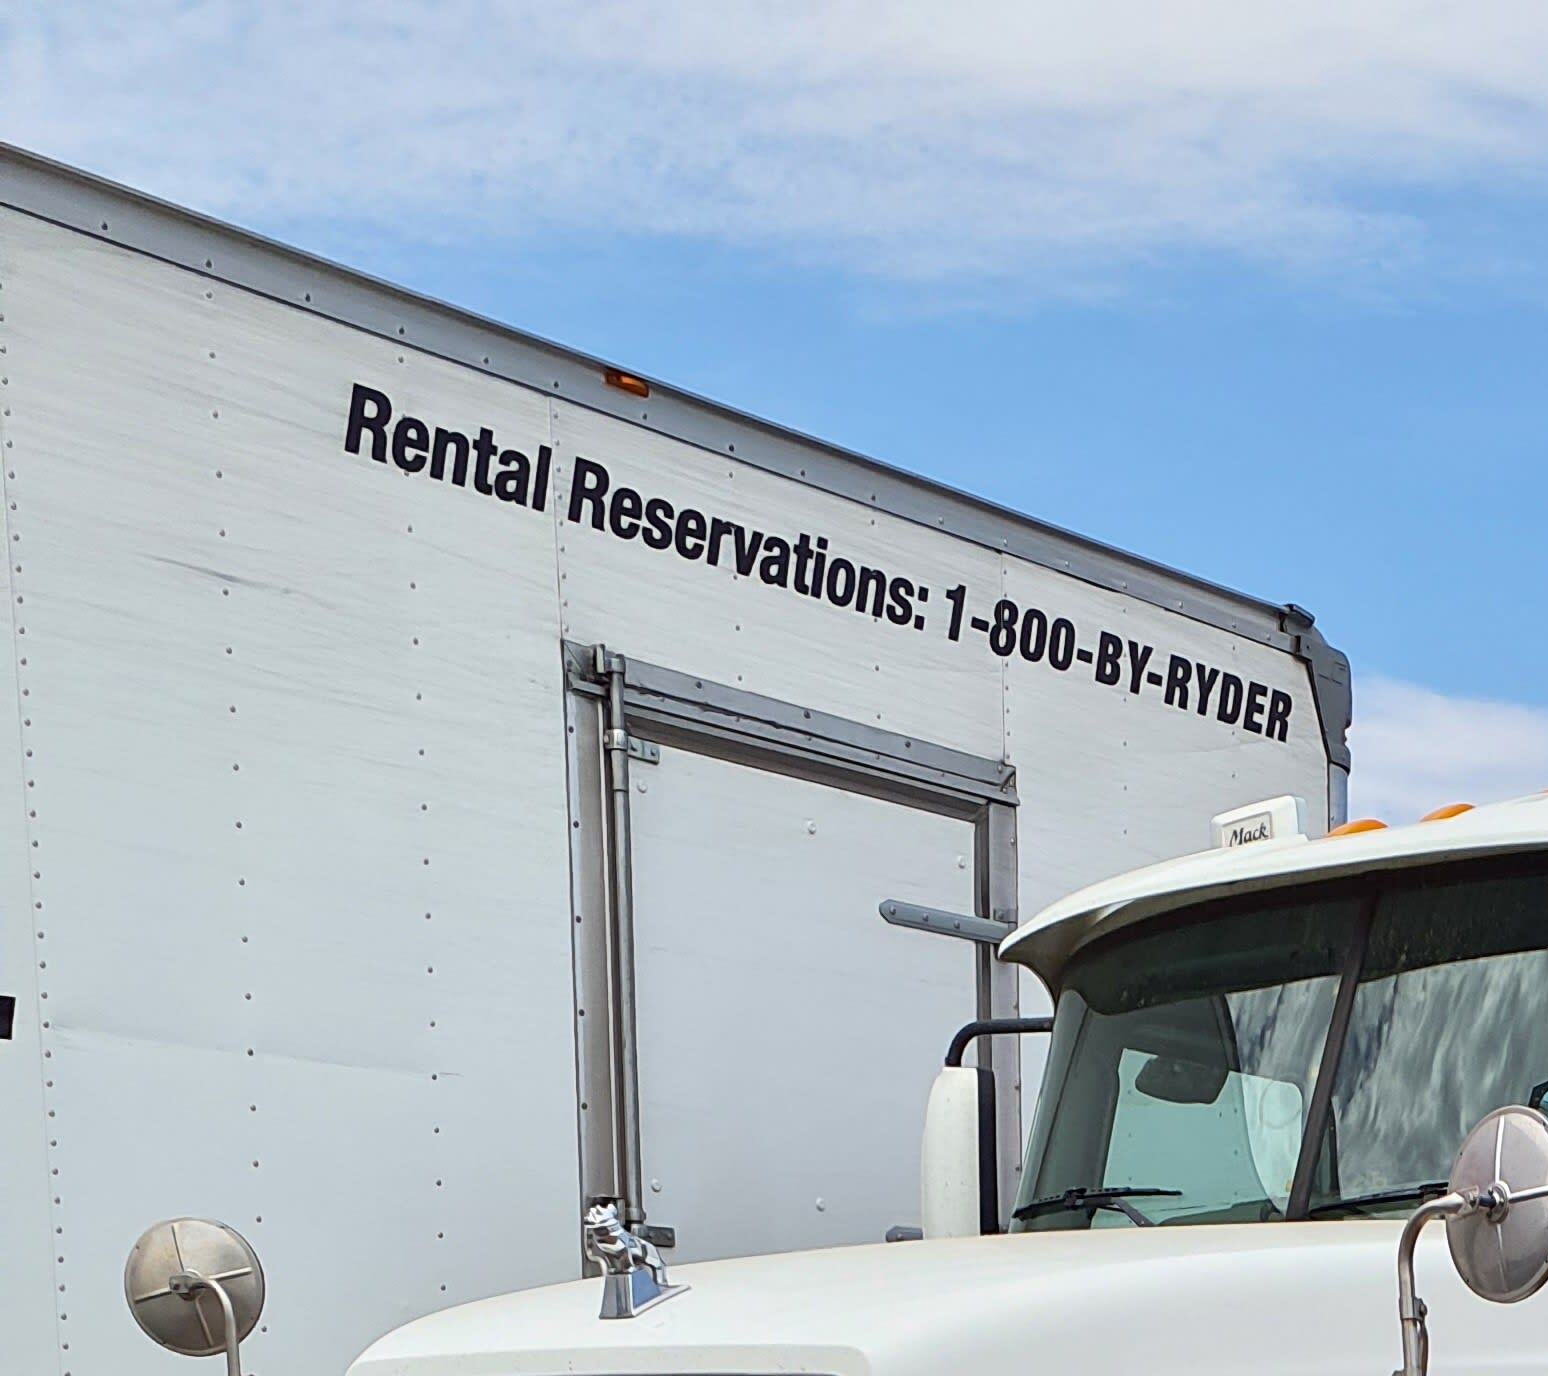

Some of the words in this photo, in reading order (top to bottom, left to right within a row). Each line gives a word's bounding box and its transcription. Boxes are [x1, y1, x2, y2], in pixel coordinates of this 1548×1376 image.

[344, 382, 553, 513] Rental
[568, 456, 928, 630] Reservations:
[945, 583, 1293, 743] 1-800-BY-RYDER
[1229, 822, 1269, 847] Mack
